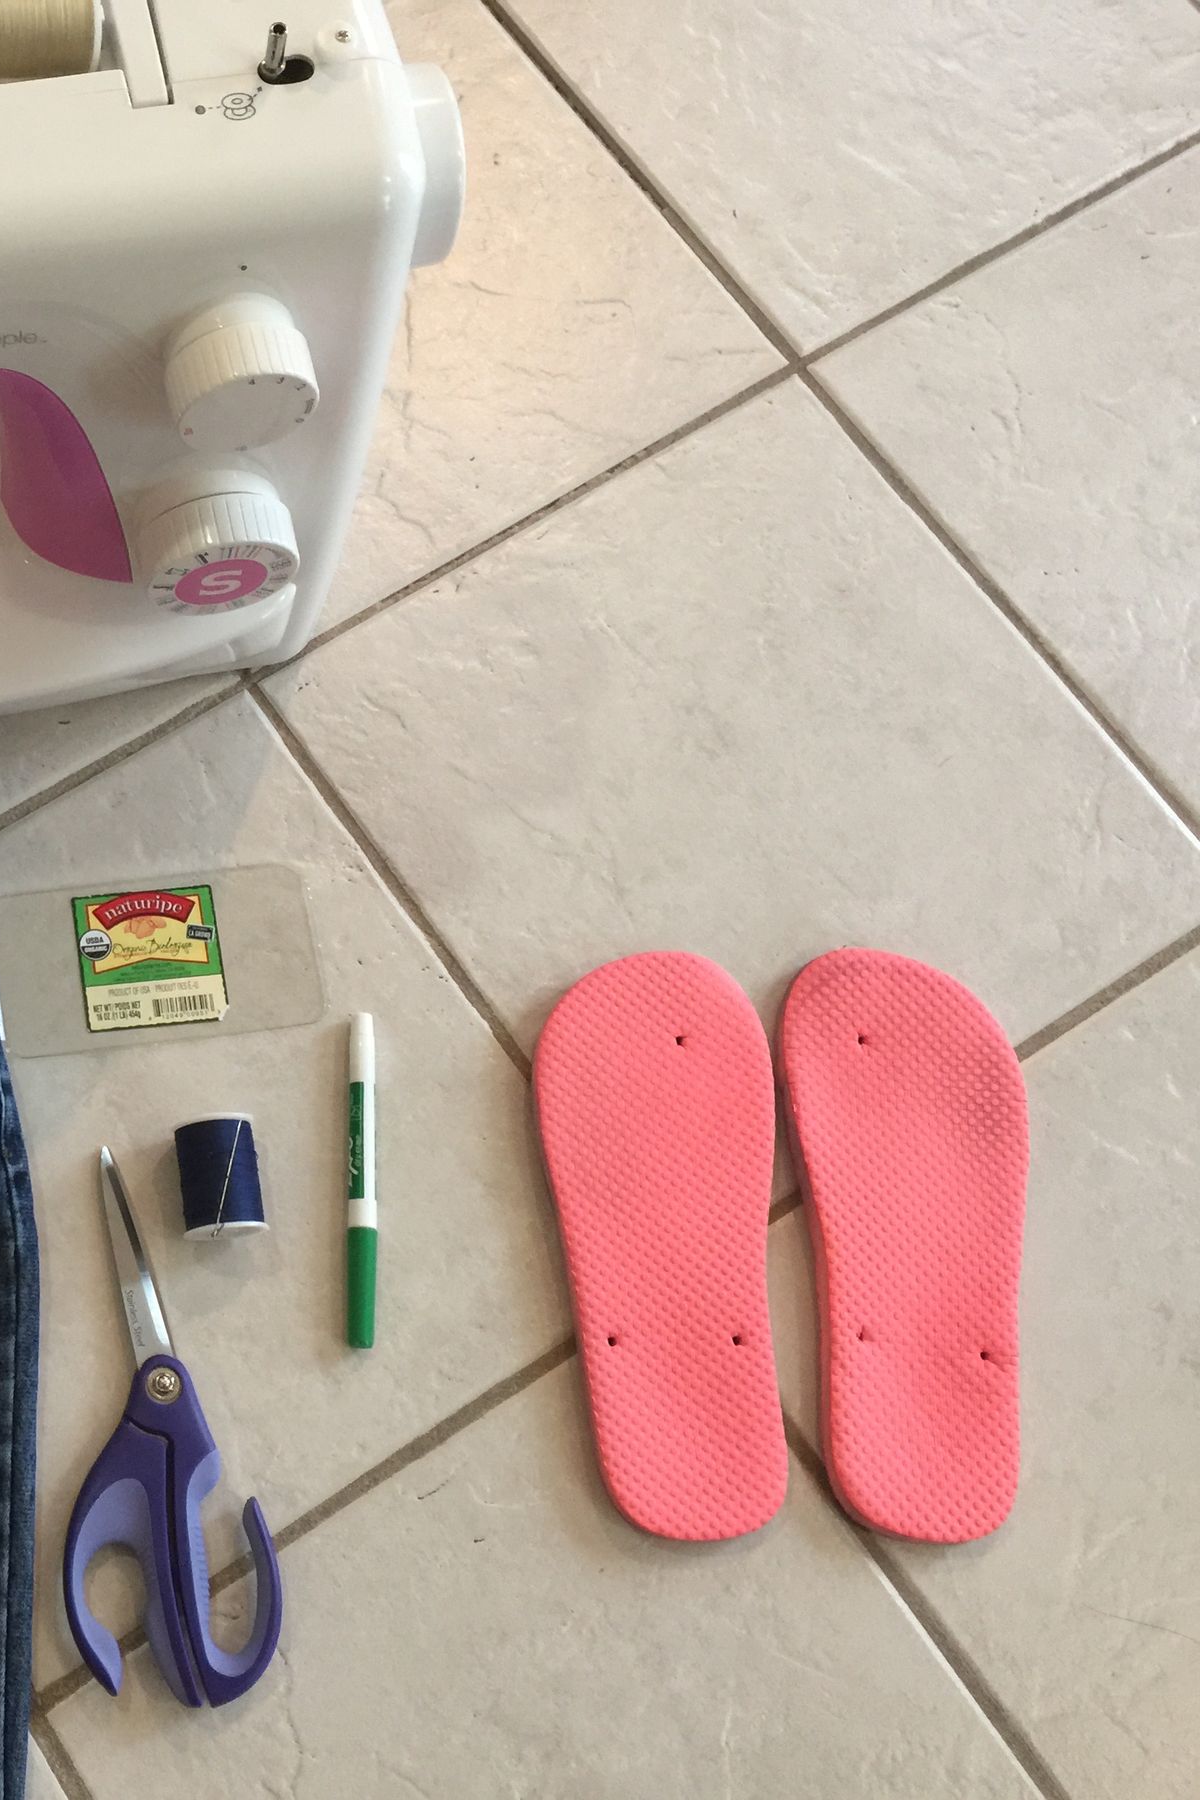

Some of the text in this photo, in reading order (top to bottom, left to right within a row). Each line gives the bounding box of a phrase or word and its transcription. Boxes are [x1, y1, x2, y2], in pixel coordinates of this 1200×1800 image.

[199, 570, 243, 596] S
[104, 895, 182, 920] naturipe
[85, 936, 104, 945] USDA
[93, 1004, 103, 1013] NET
[131, 1000, 141, 1010] NET
